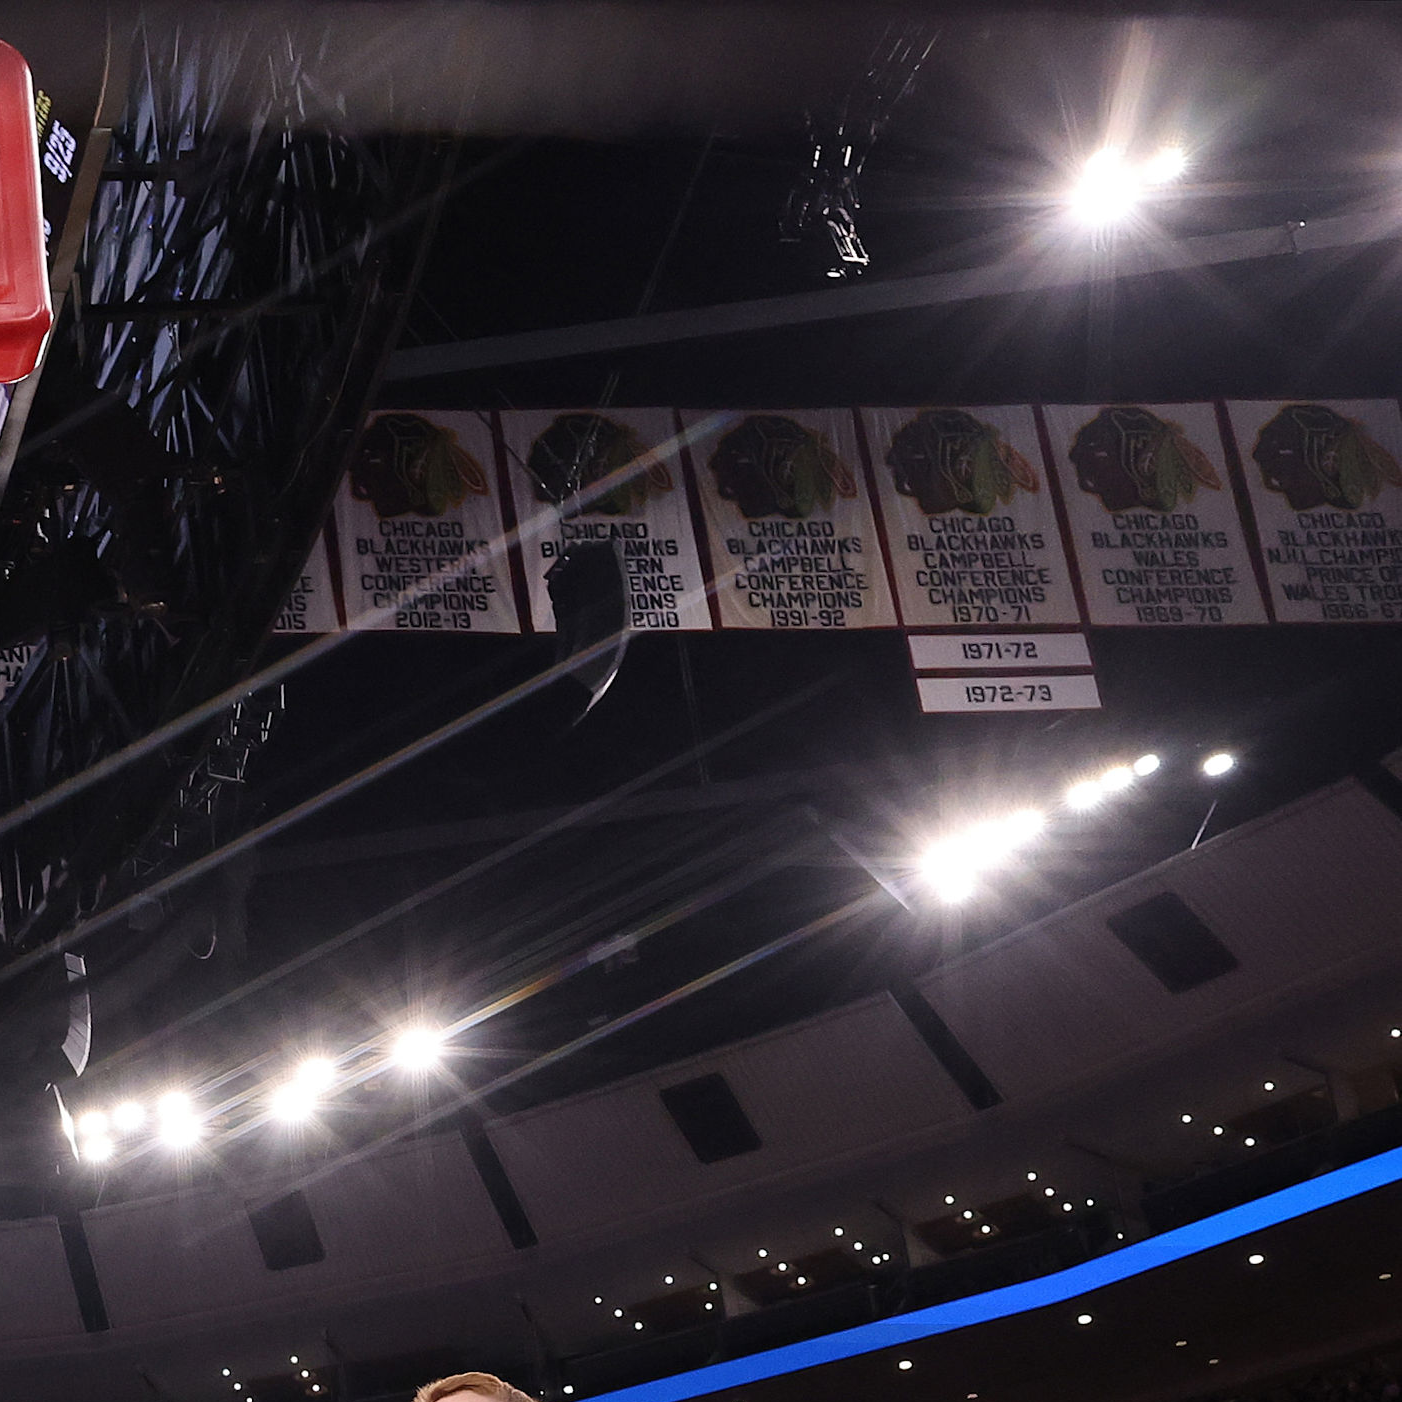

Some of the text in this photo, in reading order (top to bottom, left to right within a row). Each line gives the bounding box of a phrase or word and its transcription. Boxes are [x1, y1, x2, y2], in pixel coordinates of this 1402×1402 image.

[44, 120, 77, 183] 9/25
[379, 521, 462, 538] CHICAGO
[749, 521, 834, 538] CHICAGO
[929, 517, 1015, 534] CHICAGO
[726, 537, 862, 555] BLACKHAWKS
[907, 534, 1045, 551] BLACKHAWKS
[744, 557, 854, 574] CAMPBELL
[924, 552, 1036, 570] CAMPBELL
[736, 574, 868, 591] CONFERENCE
[916, 569, 1051, 588] CONFERENCE
[749, 592, 863, 609] CHAMPIONS
[929, 587, 1045, 605] CHAMPIONS
[396, 612, 471, 629] 2012-13
[771, 610, 845, 627] 1991-92
[952, 606, 1031, 624] 1970-71
[962, 642, 1038, 660] 1971-72
[966, 685, 1052, 703] 1972-73
